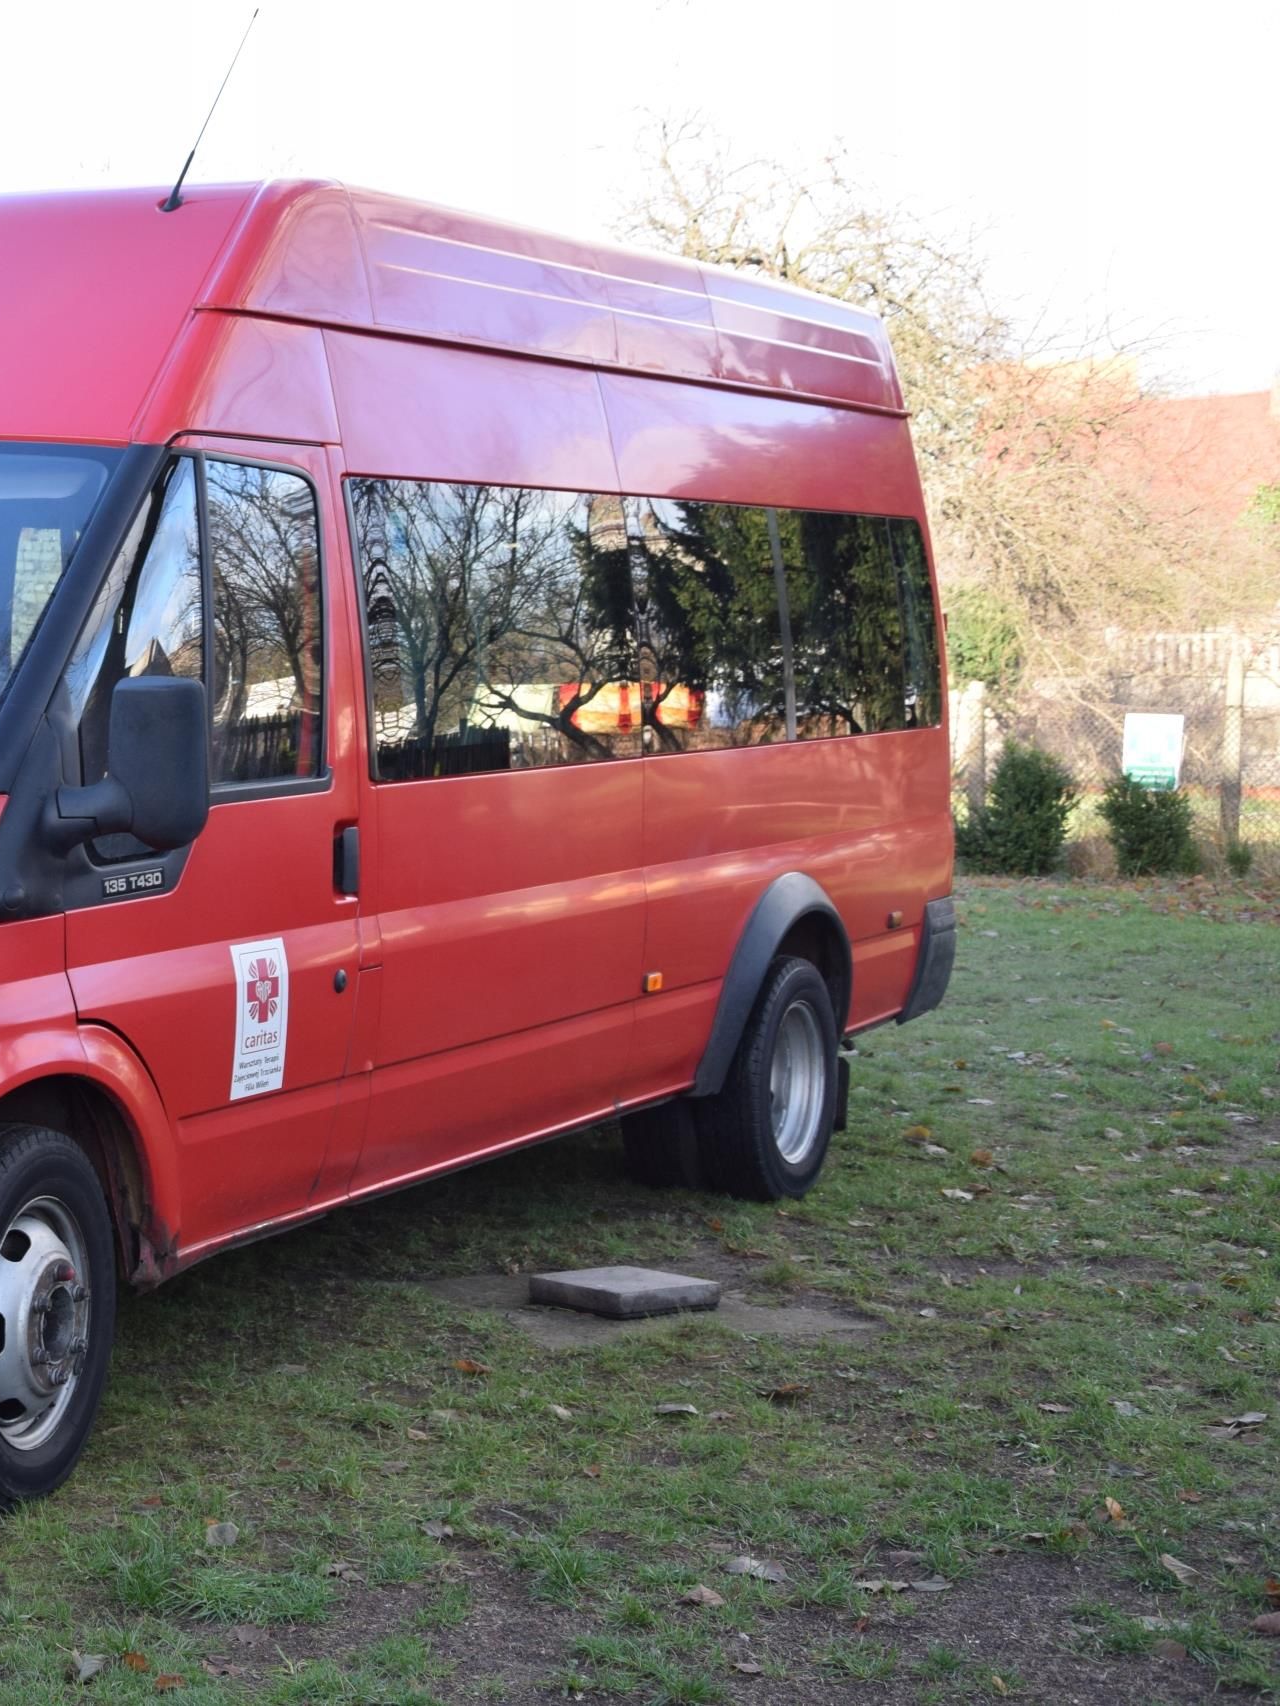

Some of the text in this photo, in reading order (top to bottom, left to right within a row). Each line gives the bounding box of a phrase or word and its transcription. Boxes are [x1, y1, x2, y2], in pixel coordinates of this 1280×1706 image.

[104, 872, 162, 894] 135 T430
[245, 1029, 277, 1048] caritas
